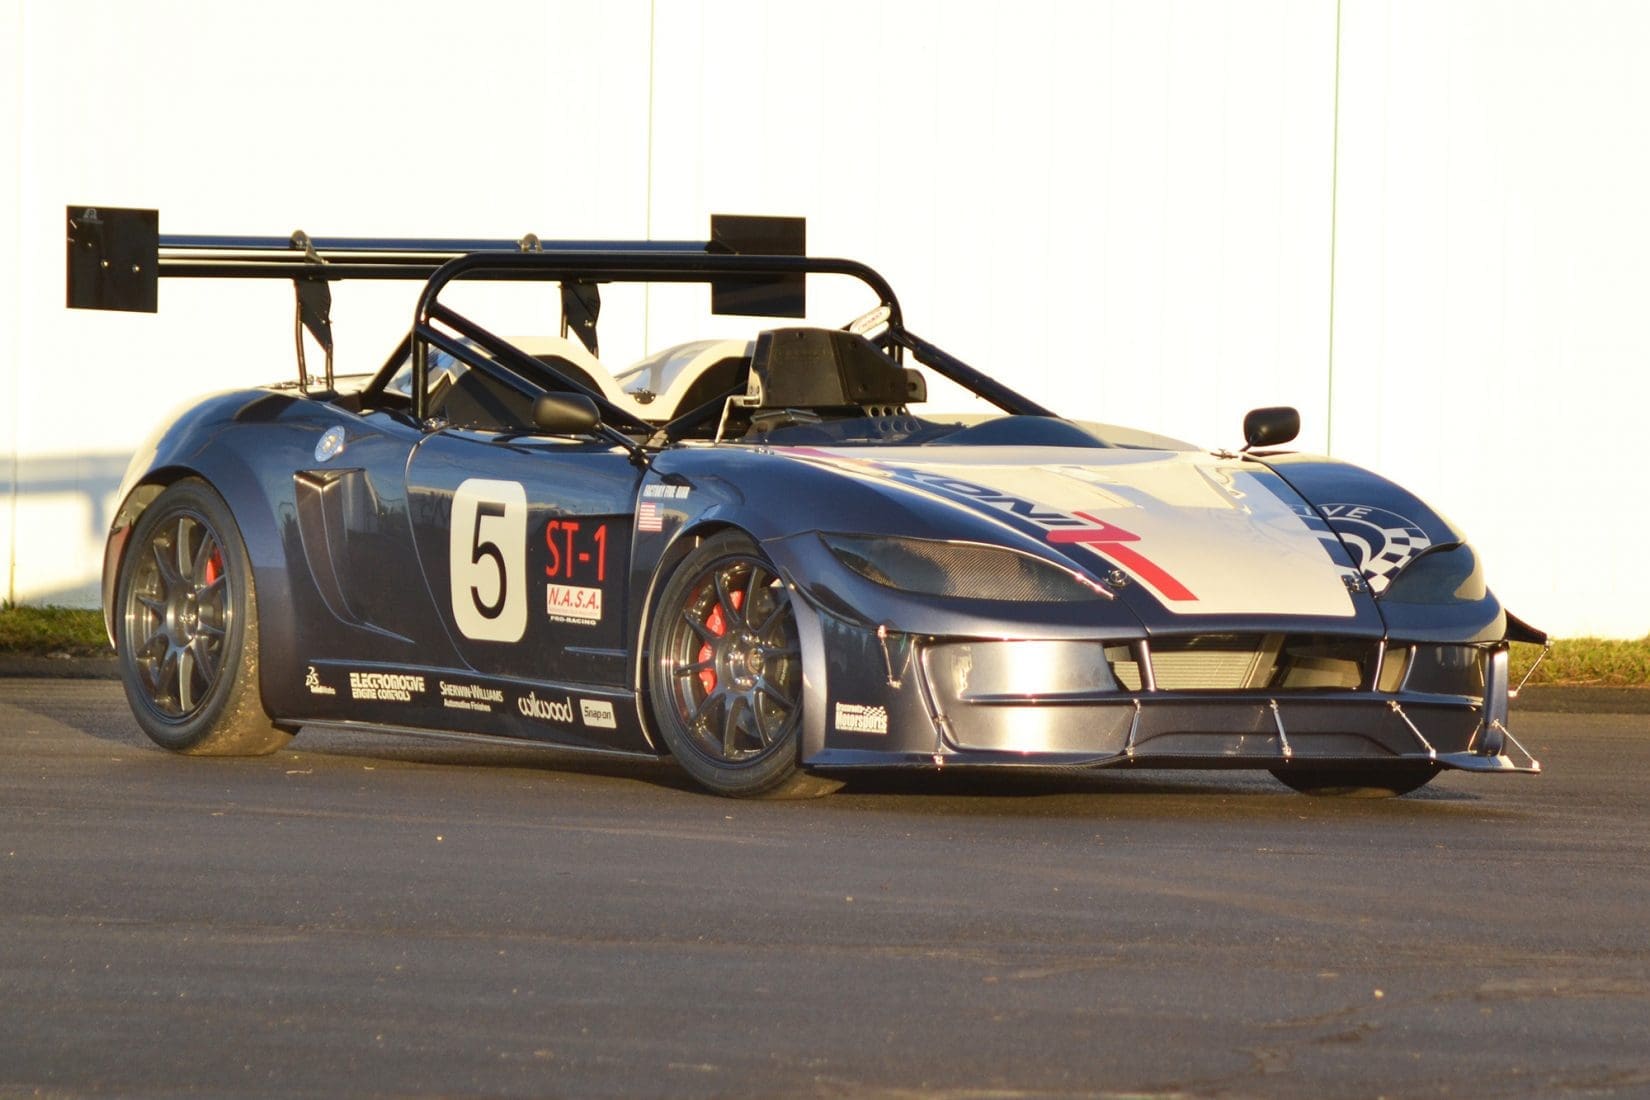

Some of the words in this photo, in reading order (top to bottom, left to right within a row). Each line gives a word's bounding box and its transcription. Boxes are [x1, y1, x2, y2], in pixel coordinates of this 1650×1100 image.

[1291, 505, 1373, 519] IVE
[470, 501, 507, 619] 5
[545, 520, 608, 582] ST-1
[548, 587, 599, 610] N.A.S.A.
[349, 672, 426, 692] ELECTROMOTIVE
[439, 680, 504, 702] SHERWIN-WILLIAMS
[351, 688, 378, 700] ENGINE
[377, 689, 411, 702] CONTROLS
